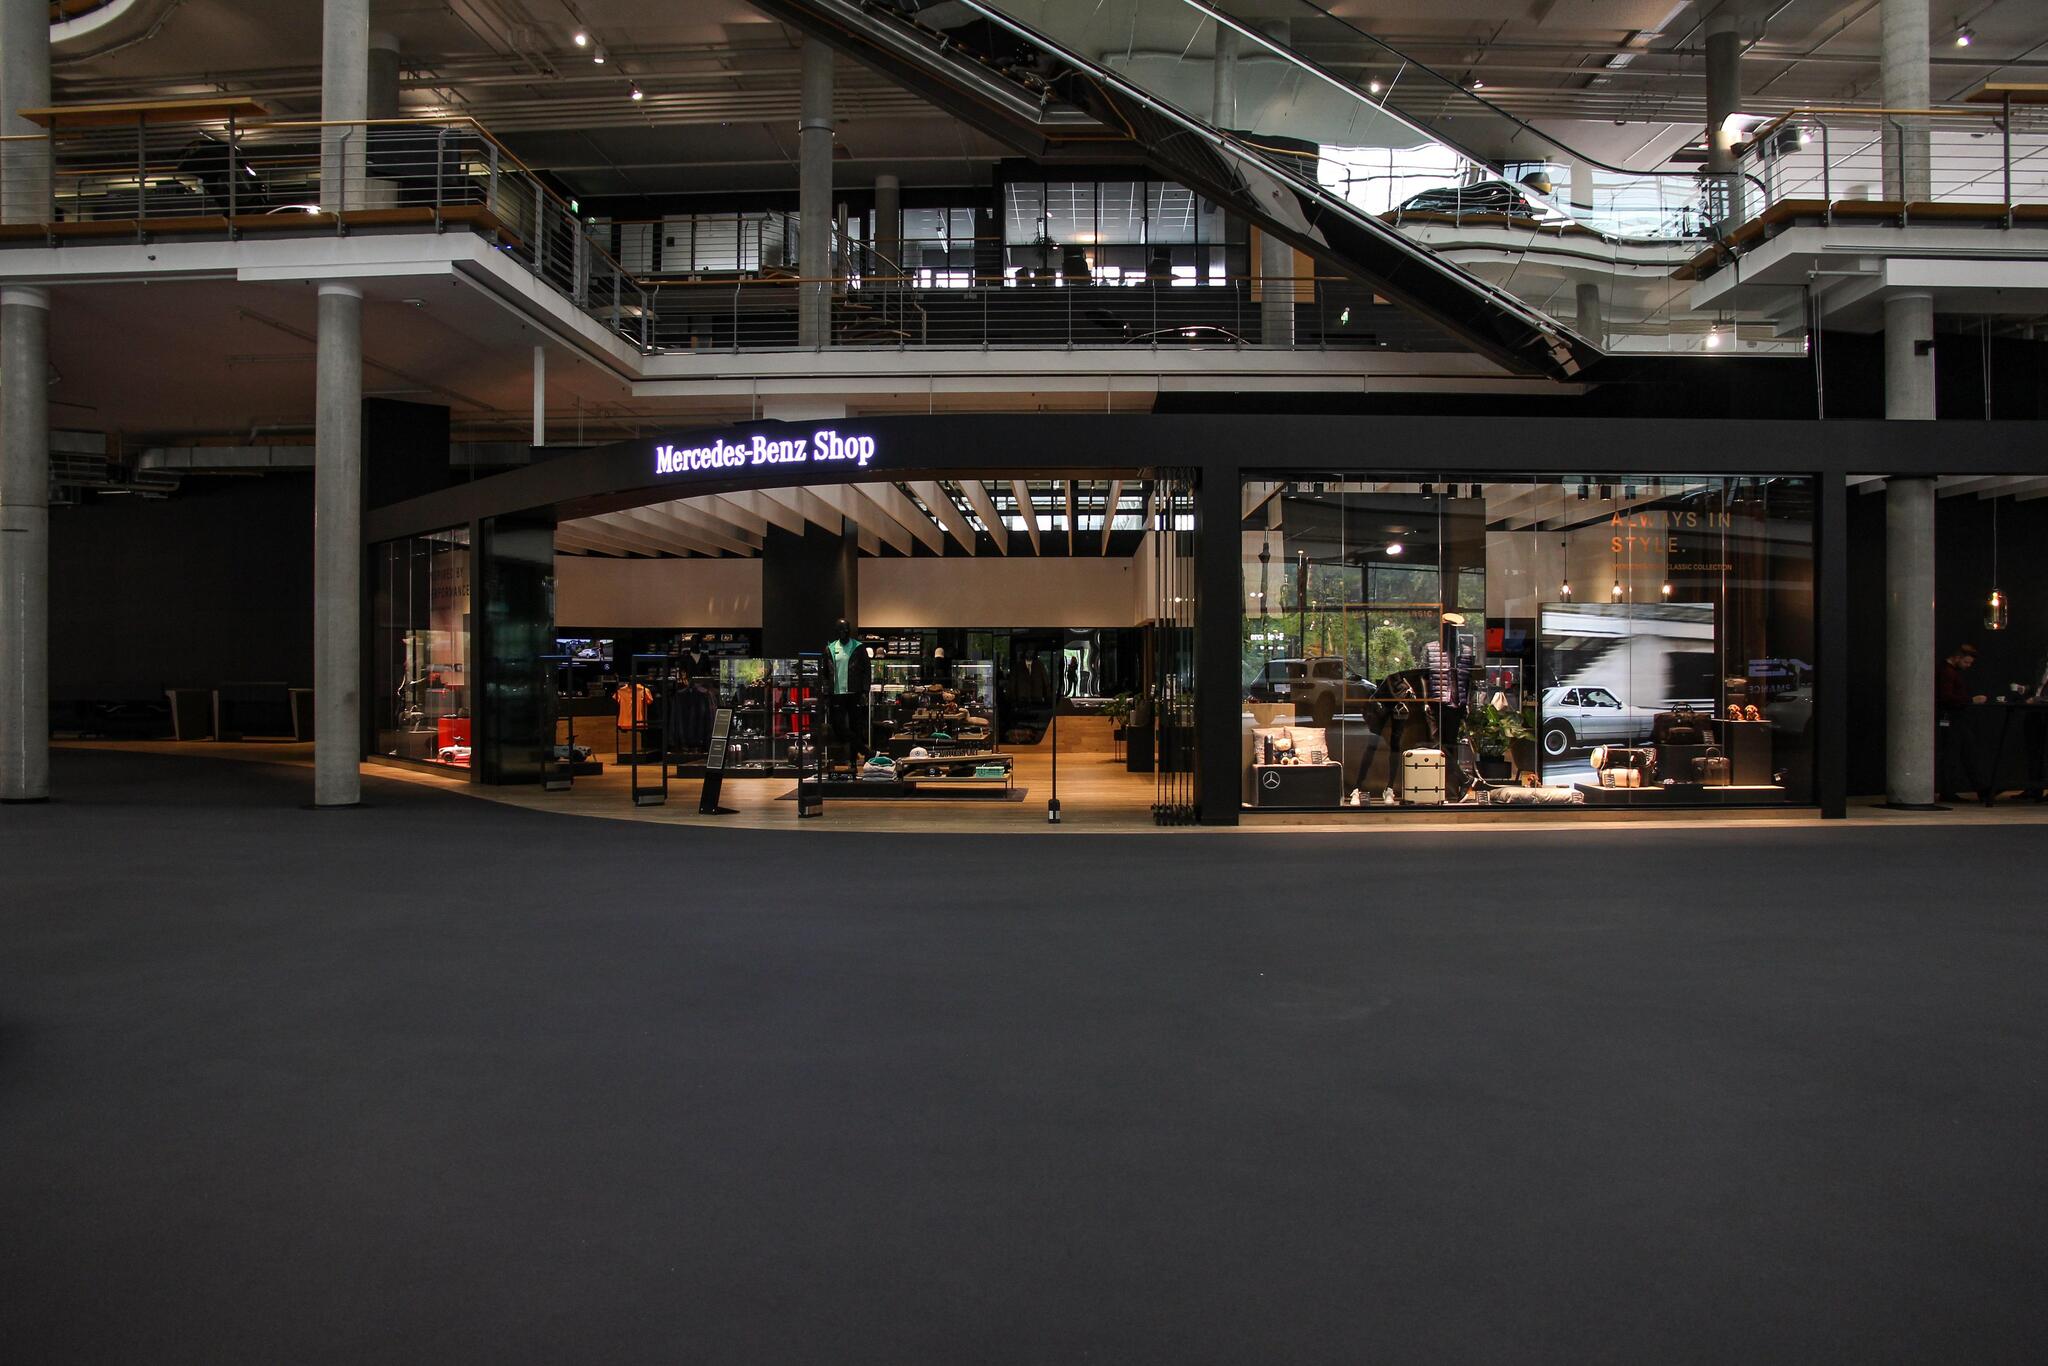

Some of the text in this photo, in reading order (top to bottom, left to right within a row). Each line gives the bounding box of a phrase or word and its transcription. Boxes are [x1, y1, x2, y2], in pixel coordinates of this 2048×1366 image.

[655, 430, 875, 473] Mercedes-Benz Shop
[1610, 511, 1731, 528] ALWAYS IN
[1611, 536, 1686, 552] STYLE.
[1694, 563, 1733, 571] COLLECTION
